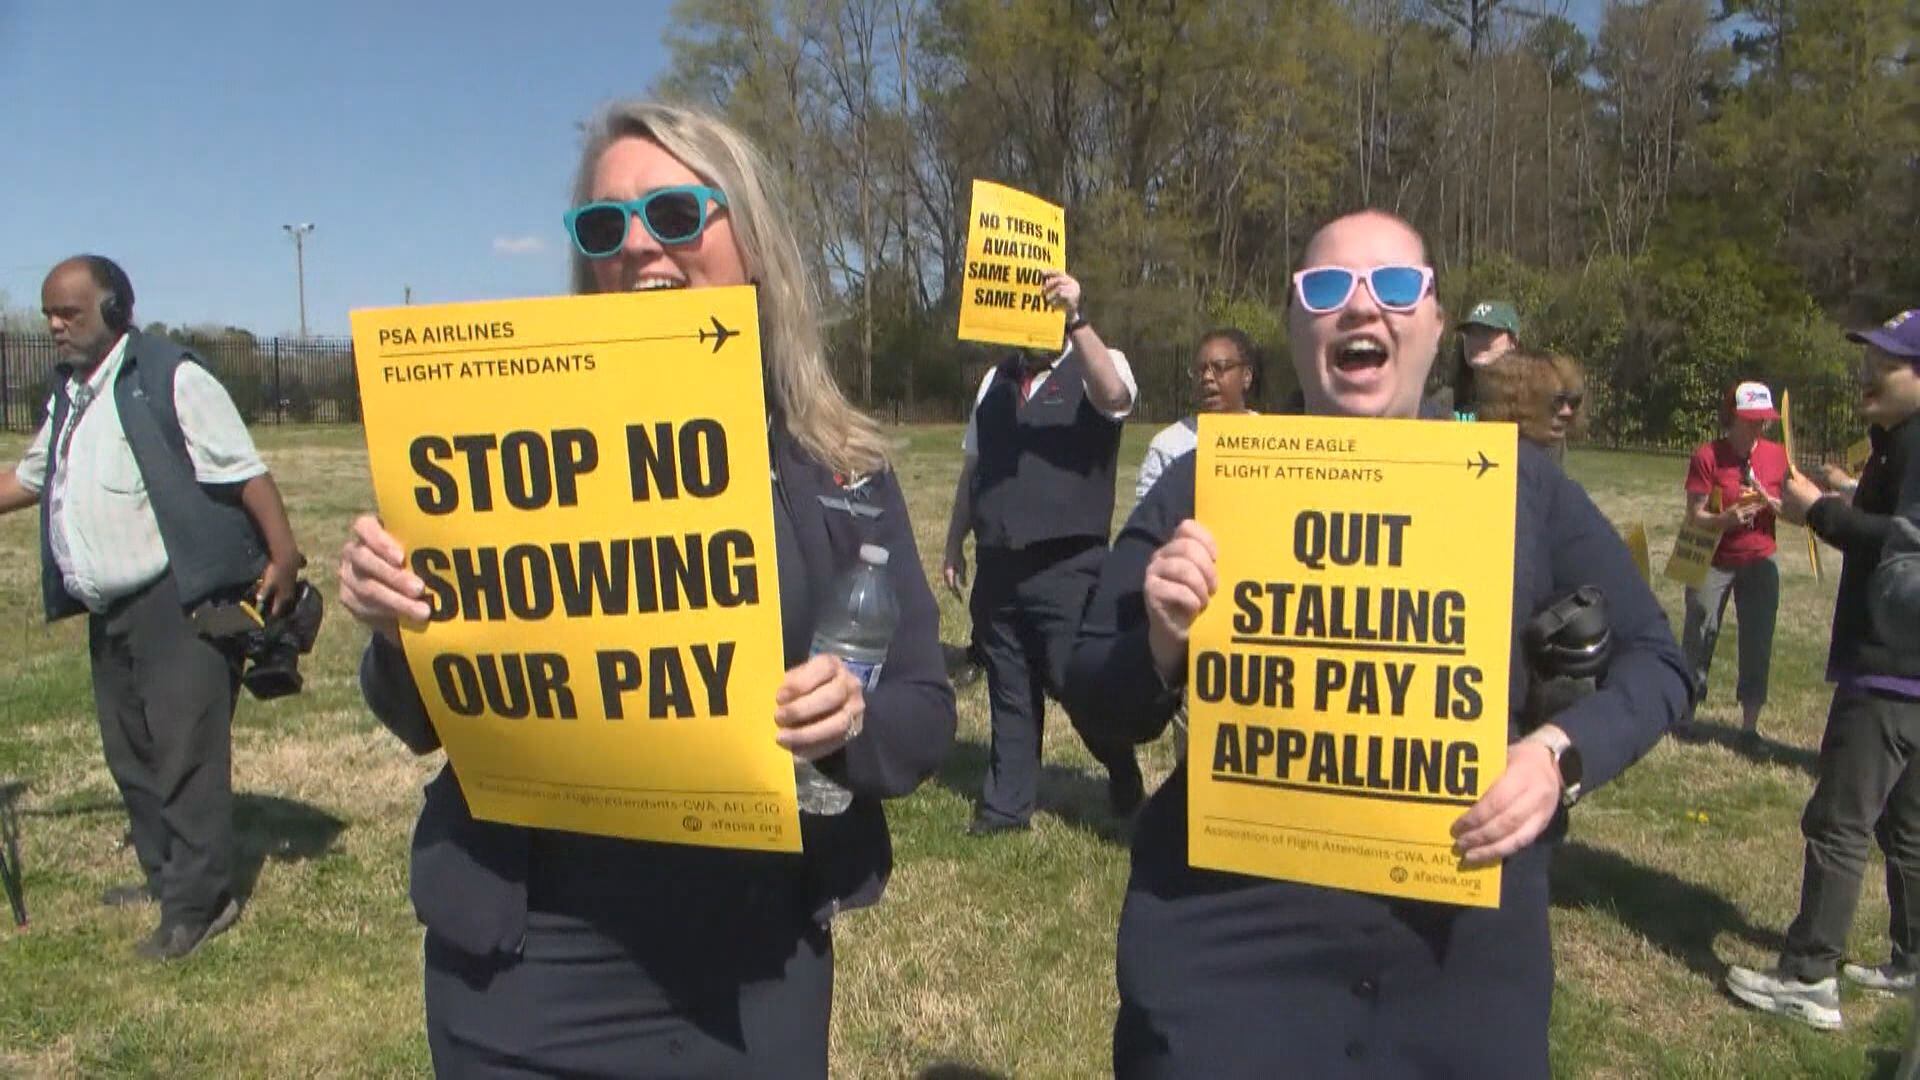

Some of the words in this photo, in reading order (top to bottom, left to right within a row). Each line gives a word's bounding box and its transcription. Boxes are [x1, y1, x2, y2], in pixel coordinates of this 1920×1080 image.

[979, 212, 999, 231] NO
[1006, 216, 1043, 240] TIERS
[1048, 229, 1060, 247] IN
[968, 261, 1011, 283] SAME
[1016, 267, 1047, 287] WO
[974, 288, 1017, 308] SAME
[379, 328, 416, 346] PSA
[423, 321, 515, 344] AIRLINES
[384, 363, 454, 383] FLIGHT
[460, 354, 597, 379] ATTENDANTS
[1215, 436, 1300, 451] AMERICAN
[1306, 438, 1357, 453] EAGLE
[409, 428, 599, 516] STOP
[626, 418, 731, 502] NO
[1215, 464, 1270, 479] FLIGHT
[1275, 466, 1383, 482] ATTENDANTS
[1293, 509, 1412, 570] QUIT
[411, 529, 760, 623] SHOWING
[1232, 580, 1466, 646] STALLING
[432, 652, 579, 720] OUR
[596, 641, 737, 720] PAY
[1196, 650, 1295, 709] OUR
[1314, 658, 1416, 717] PAY
[1434, 664, 1484, 721] IS
[1211, 722, 1479, 796] APPALLING
[1412, 870, 1482, 891] afacwa.org
